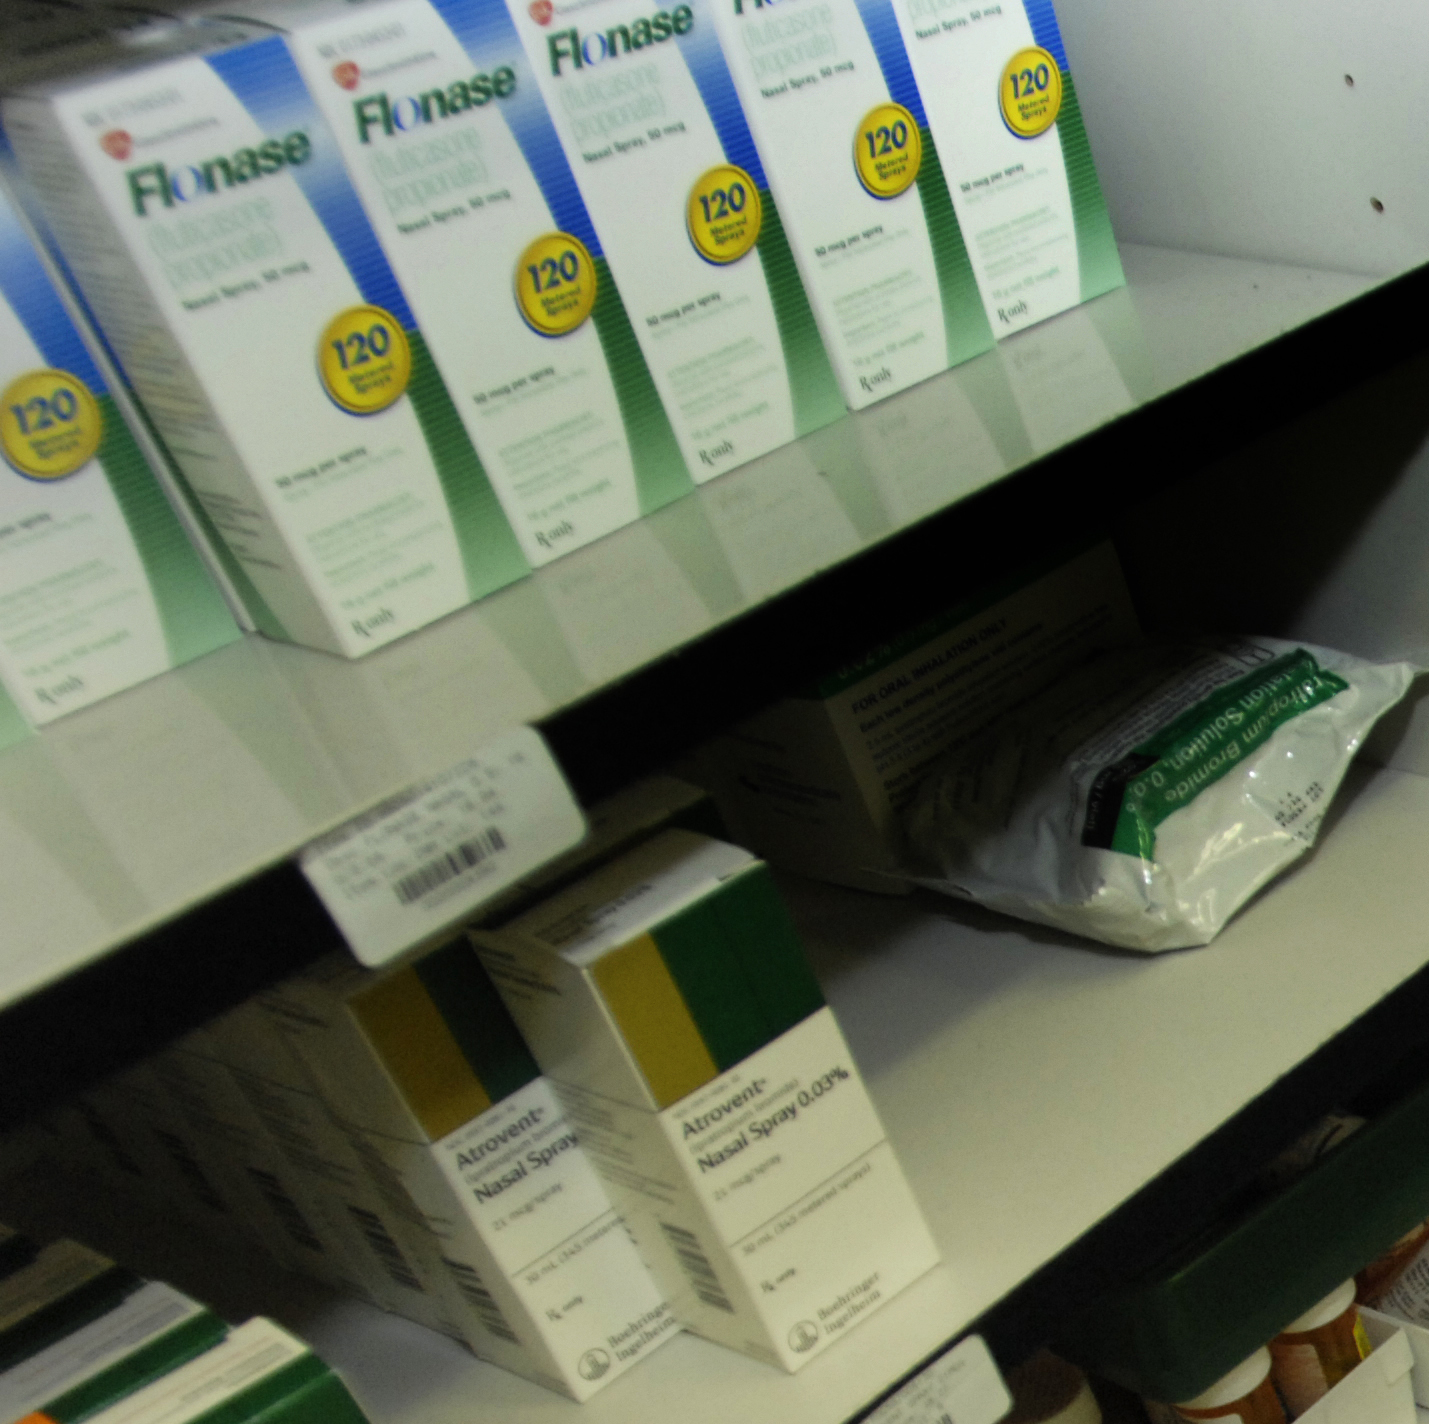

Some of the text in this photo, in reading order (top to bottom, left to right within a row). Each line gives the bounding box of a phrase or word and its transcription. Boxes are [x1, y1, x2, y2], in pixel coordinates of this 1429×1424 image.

[547, 4, 694, 77] Flonase
[915, 24, 941, 40] Nasal
[970, 11, 982, 22] 50
[983, 4, 1002, 19] mcg
[353, 66, 517, 144] Flonase
[1010, 63, 1050, 100] 120
[865, 120, 908, 159] 120
[125, 131, 312, 216] Flonase
[960, 162, 1025, 193] 50 mcg per spray
[699, 182, 747, 224] 120
[527, 250, 580, 294] 120
[332, 325, 391, 370] 120
[10, 387, 79, 436] 120
[851, 691, 879, 714] FOR
[879, 671, 913, 700] ORAL
[1163, 740, 1241, 803] Bromide
[680, 1078, 762, 1141] Atrovent
[696, 1065, 851, 1175] Nasal Spray 0.03%
[455, 1107, 540, 1171] Atrovent
[472, 1130, 581, 1205] Nasal Spray
[816, 1270, 881, 1322] Boehringer
[823, 1289, 882, 1336] Ingelheim
